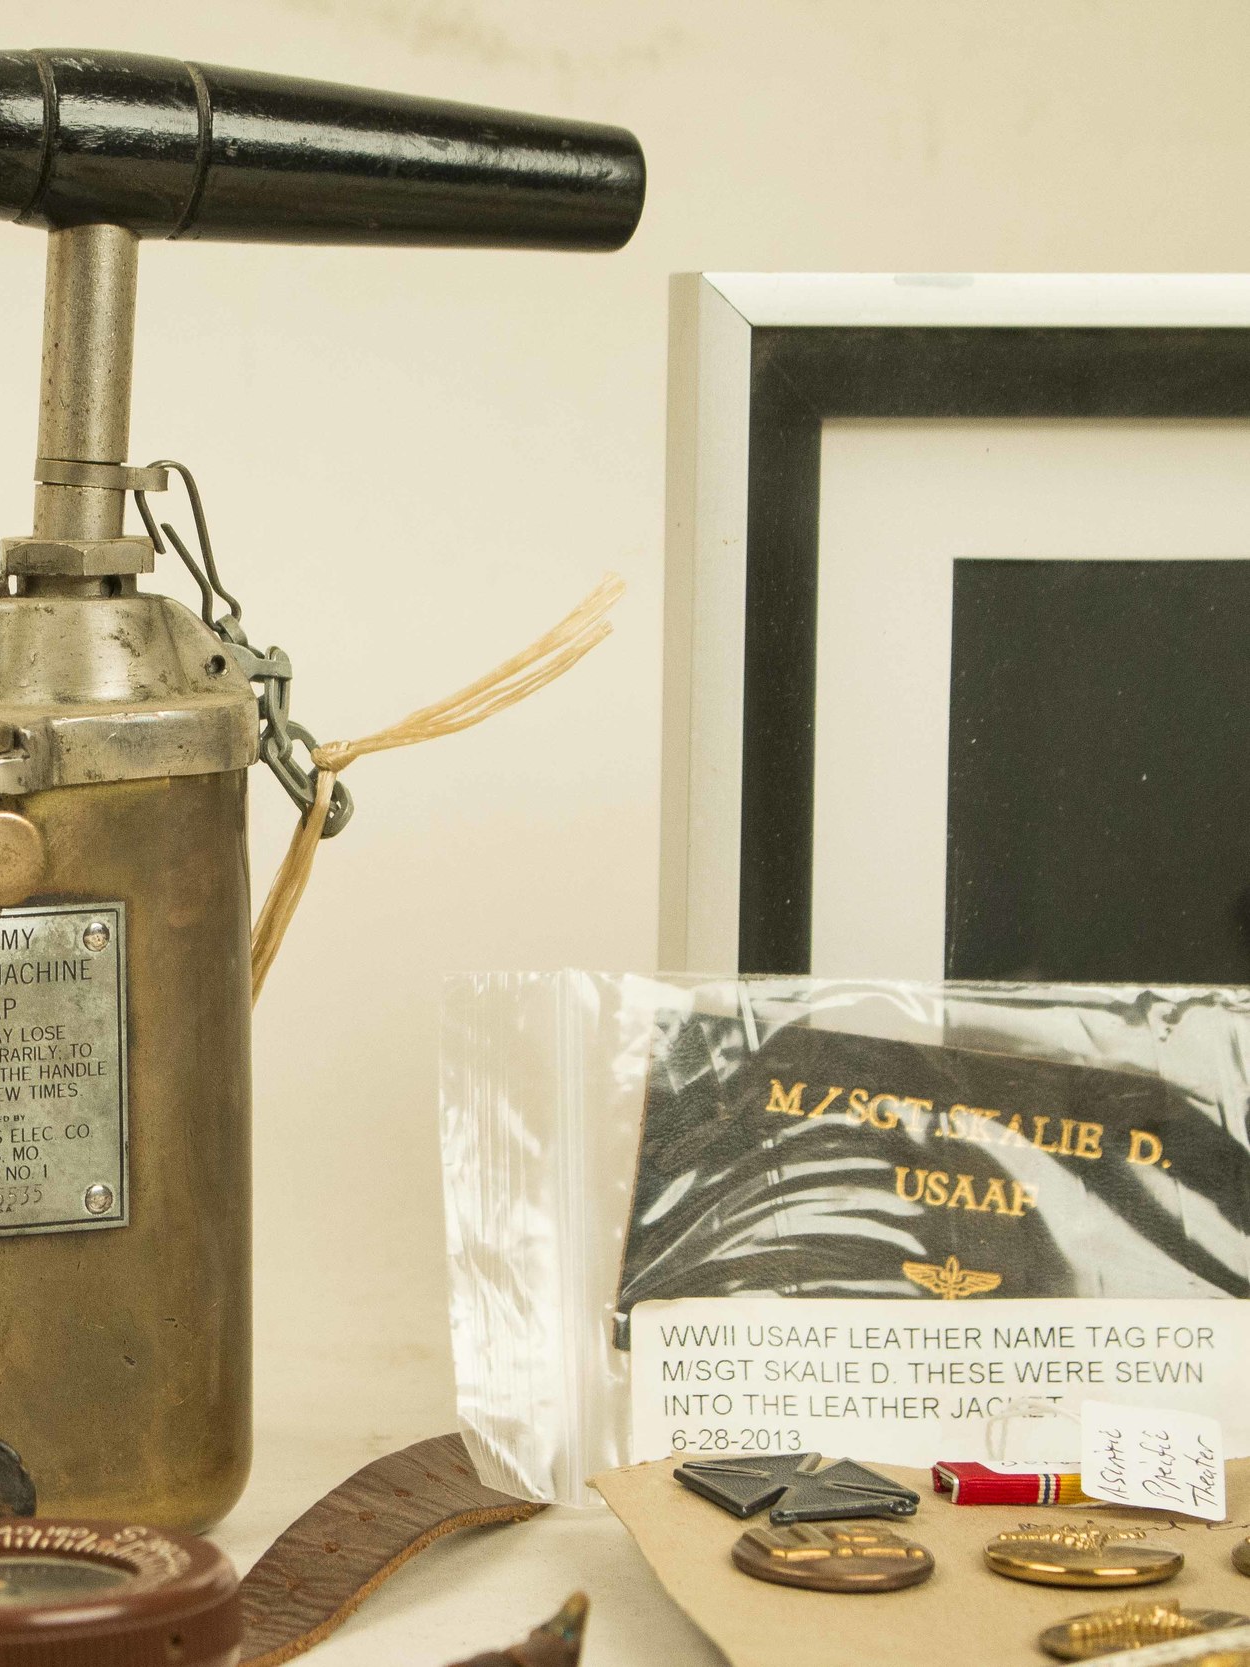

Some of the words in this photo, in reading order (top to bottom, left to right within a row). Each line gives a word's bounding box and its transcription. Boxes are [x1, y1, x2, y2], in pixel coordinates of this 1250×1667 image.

[21, 1025, 66, 1042] LOSE
[70, 1043, 92, 1058] TO
[0, 1066, 32, 1082] THE
[39, 1061, 107, 1080] HANDLE
[29, 1082, 83, 1100] TIMES.
[13, 1114, 26, 1122] BY
[948, 1104, 1103, 1160] SKALIE
[1126, 1127, 1173, 1169] D.
[895, 1166, 1040, 1216] USAAF
[660, 1325, 736, 1347] WWII
[747, 1325, 838, 1349] USAAF
[849, 1327, 982, 1349] LEATHER
[993, 1326, 1075, 1349] NAME
[1085, 1326, 1146, 1349] TAG
[1156, 1326, 1214, 1349] FOR
[662, 1359, 754, 1381] M/SGT
[764, 1360, 861, 1383] SKALIE
[872, 1362, 898, 1384] D.
[908, 1362, 1005, 1384] THESE
[1015, 1361, 1105, 1383] WERE
[1116, 1361, 1204, 1383] SEWN
[664, 1394, 733, 1416] INTO
[743, 1394, 799, 1417] THE
[809, 1395, 941, 1419] LEATHER
[671, 1428, 802, 1451] 6-28-2013
